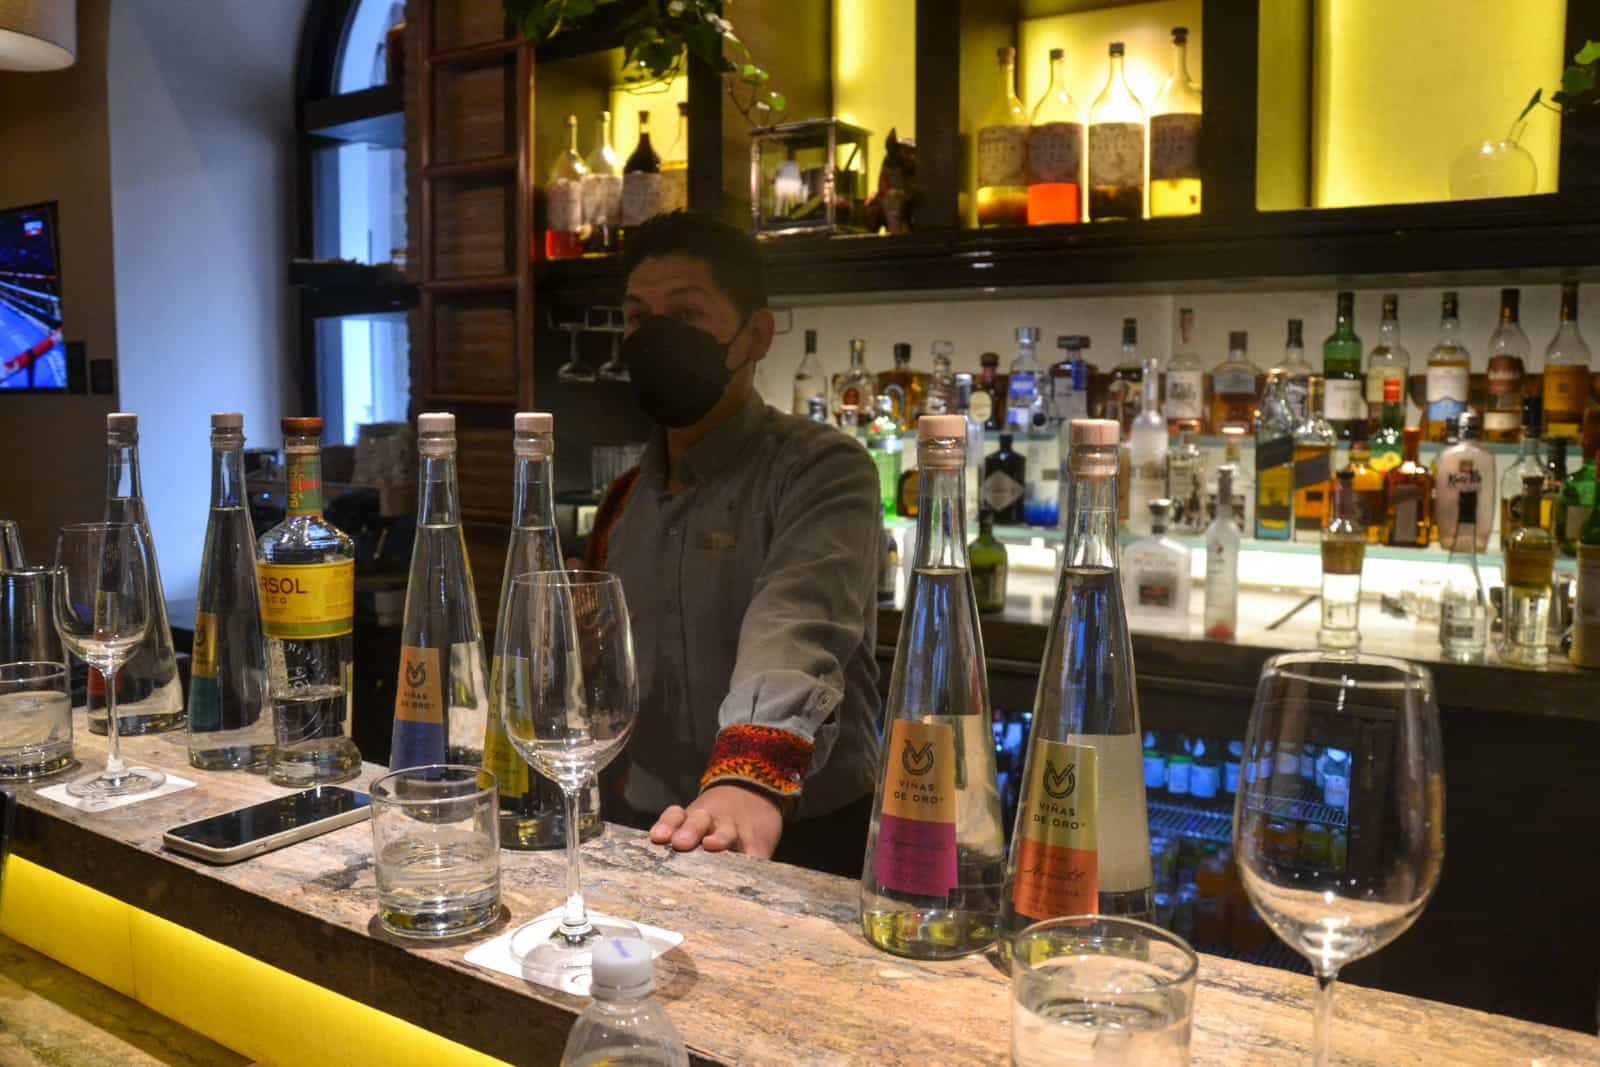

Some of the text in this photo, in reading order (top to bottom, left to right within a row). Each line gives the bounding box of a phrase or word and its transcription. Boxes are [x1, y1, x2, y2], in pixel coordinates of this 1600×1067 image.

[895, 791, 938, 804] DE ORO
[1039, 801, 1076, 817] VIÑAS
[1034, 814, 1079, 830] DE ORO
